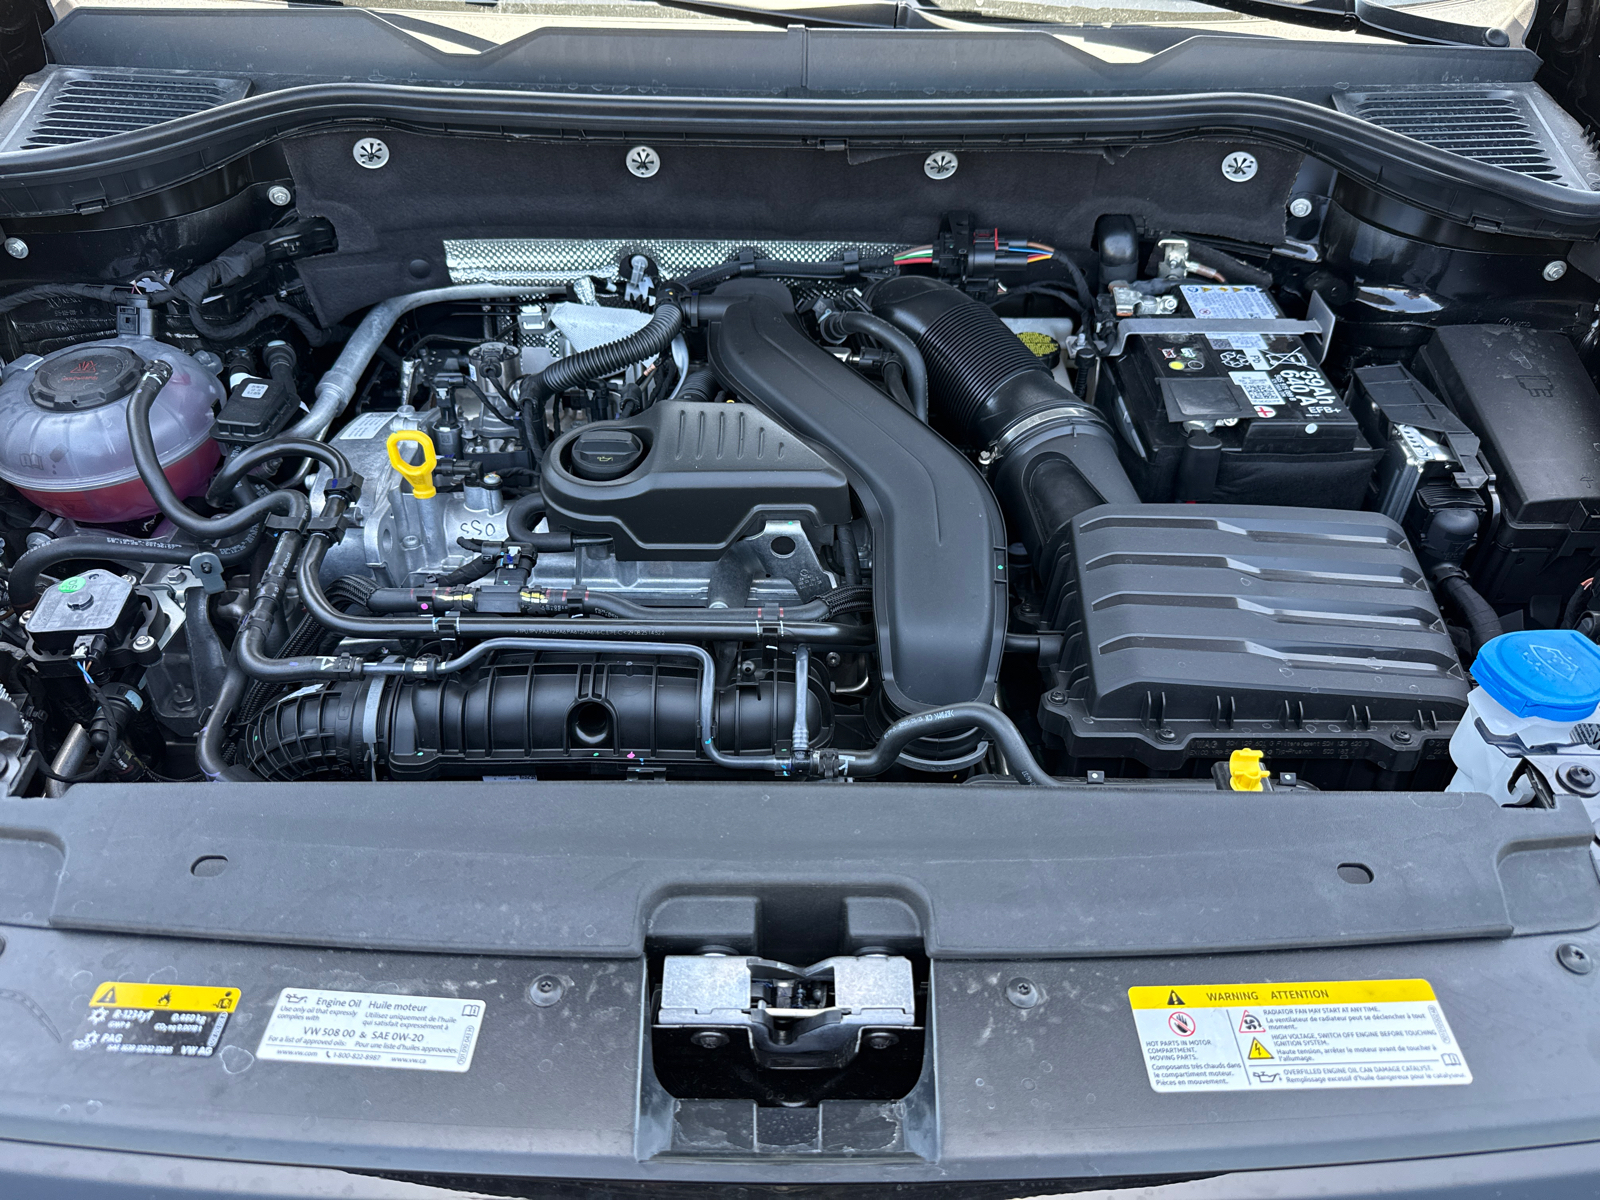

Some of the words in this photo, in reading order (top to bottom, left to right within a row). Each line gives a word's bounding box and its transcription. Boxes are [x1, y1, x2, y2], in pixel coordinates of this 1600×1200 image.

[1280, 370, 1310, 393] 640
[1295, 395, 1318, 406] A
[1300, 371, 1336, 404] 59Ah
[1307, 406, 1341, 414] EFB+
[1206, 991, 1259, 1001] WARNING
[1271, 989, 1329, 1000] ATTENTION
[316, 997, 347, 1008] Engine
[348, 999, 362, 1008] Oil
[368, 1000, 392, 1010] Huile
[393, 1003, 427, 1011] moteur
[277, 1013, 304, 1021] complies
[292, 1006, 305, 1014] only
[329, 1009, 358, 1017] expressly
[390, 1013, 427, 1021] uniquement
[1348, 1015, 1363, 1023] peut
[400, 1022, 443, 1030] expressément
[100, 1033, 123, 1044] PAG
[268, 1034, 278, 1042] For
[304, 1026, 321, 1035] VW
[322, 1027, 341, 1037] 508
[342, 1029, 356, 1038] 00
[371, 1031, 390, 1040] SAE
[391, 1032, 424, 1042] 0W-20
[1287, 1032, 1318, 1040] VOLTAGE,
[181, 1045, 198, 1055] VW
[197, 1046, 213, 1056] AG
[396, 1043, 420, 1051] d'huiles
[421, 1046, 458, 1054] approuvées:
[333, 1051, 381, 1061] 1-800-822-8987
[391, 1056, 426, 1064] www.vw.ca
[1151, 1063, 1190, 1071] Composants
[1161, 1071, 1208, 1079] compartiment
[1286, 1076, 1326, 1084] Remplissage
